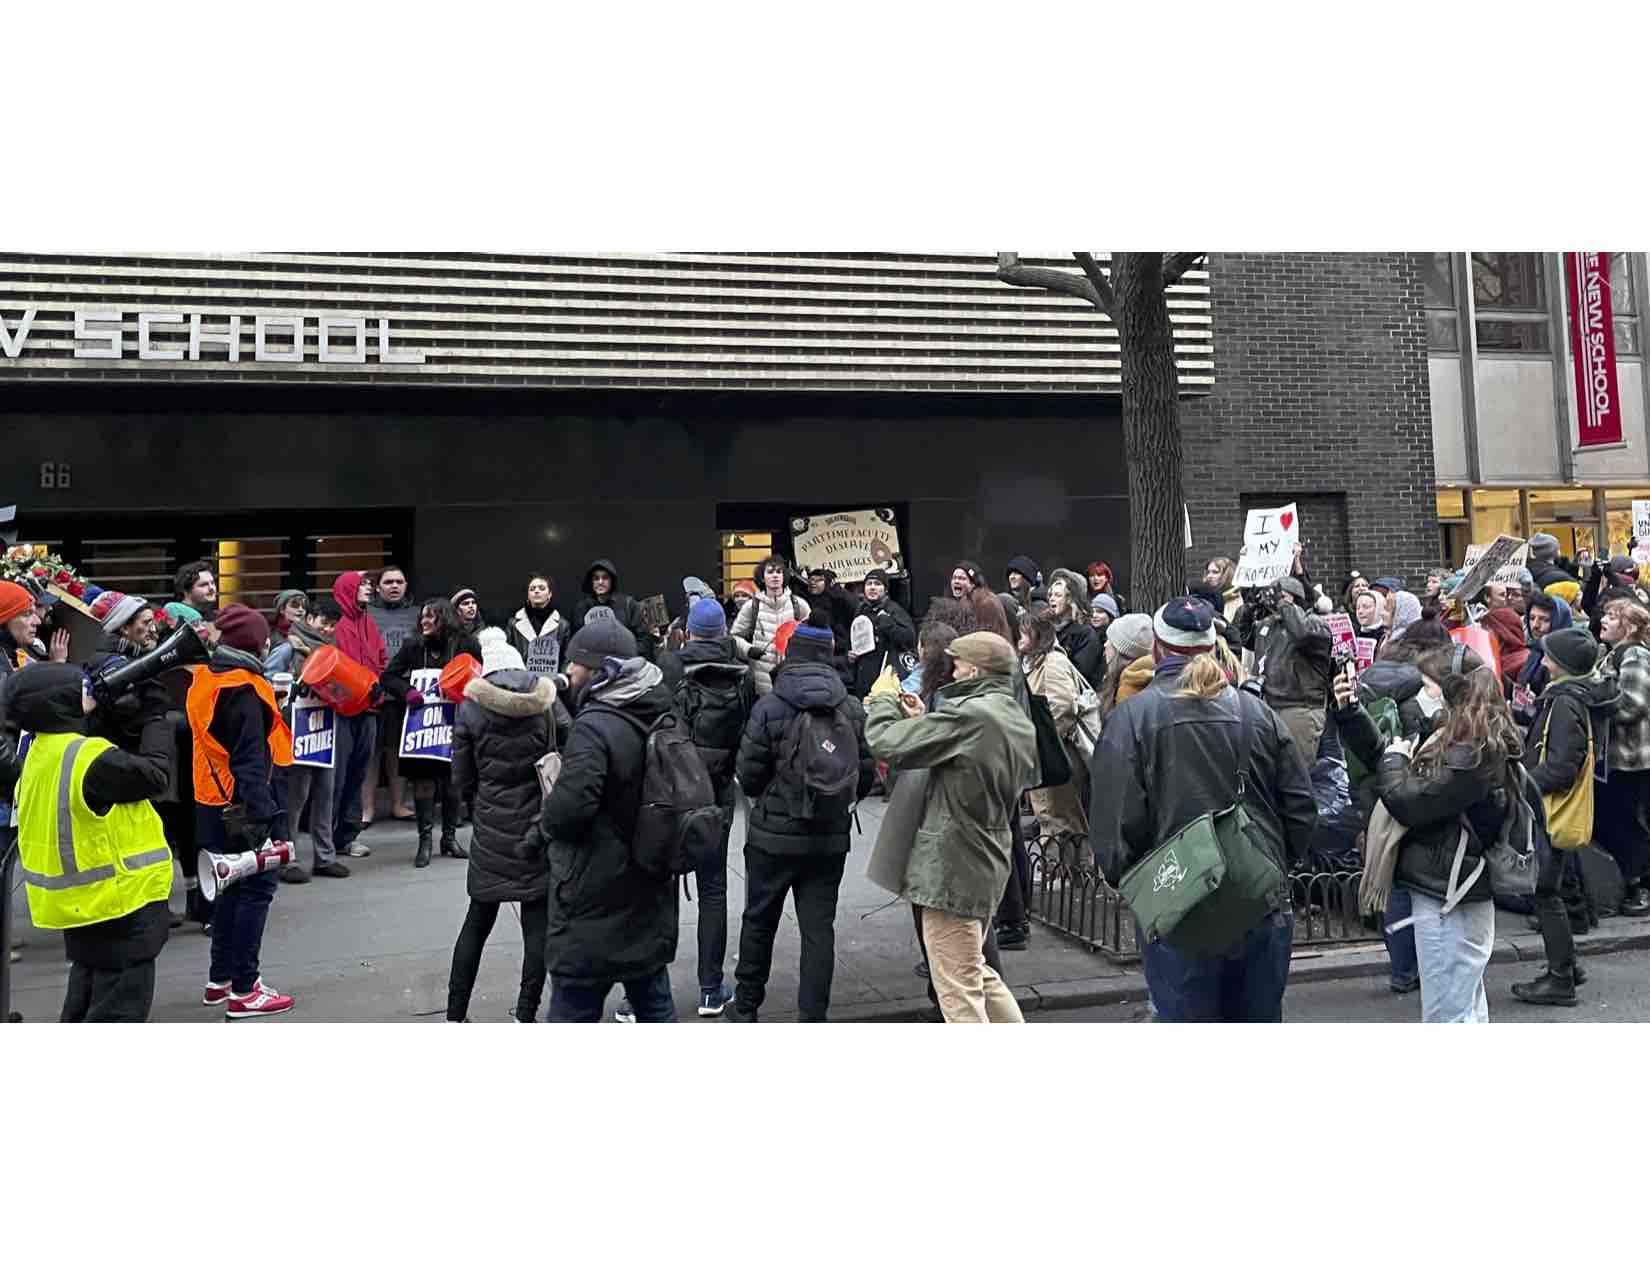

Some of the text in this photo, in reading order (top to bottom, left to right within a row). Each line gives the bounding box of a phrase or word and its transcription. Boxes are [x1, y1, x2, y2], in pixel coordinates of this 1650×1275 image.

[1587, 271, 1604, 329] NEW
[74, 311, 426, 364] SCHOOL
[1591, 331, 1610, 416] SCHOOL
[40, 461, 71, 488] 66
[1251, 514, 1275, 535] I
[1258, 538, 1281, 555] MY
[308, 710, 324, 731] ON
[423, 707, 443, 727] ON
[295, 729, 333, 757] STRIKE
[405, 726, 453, 752] STRIKE
